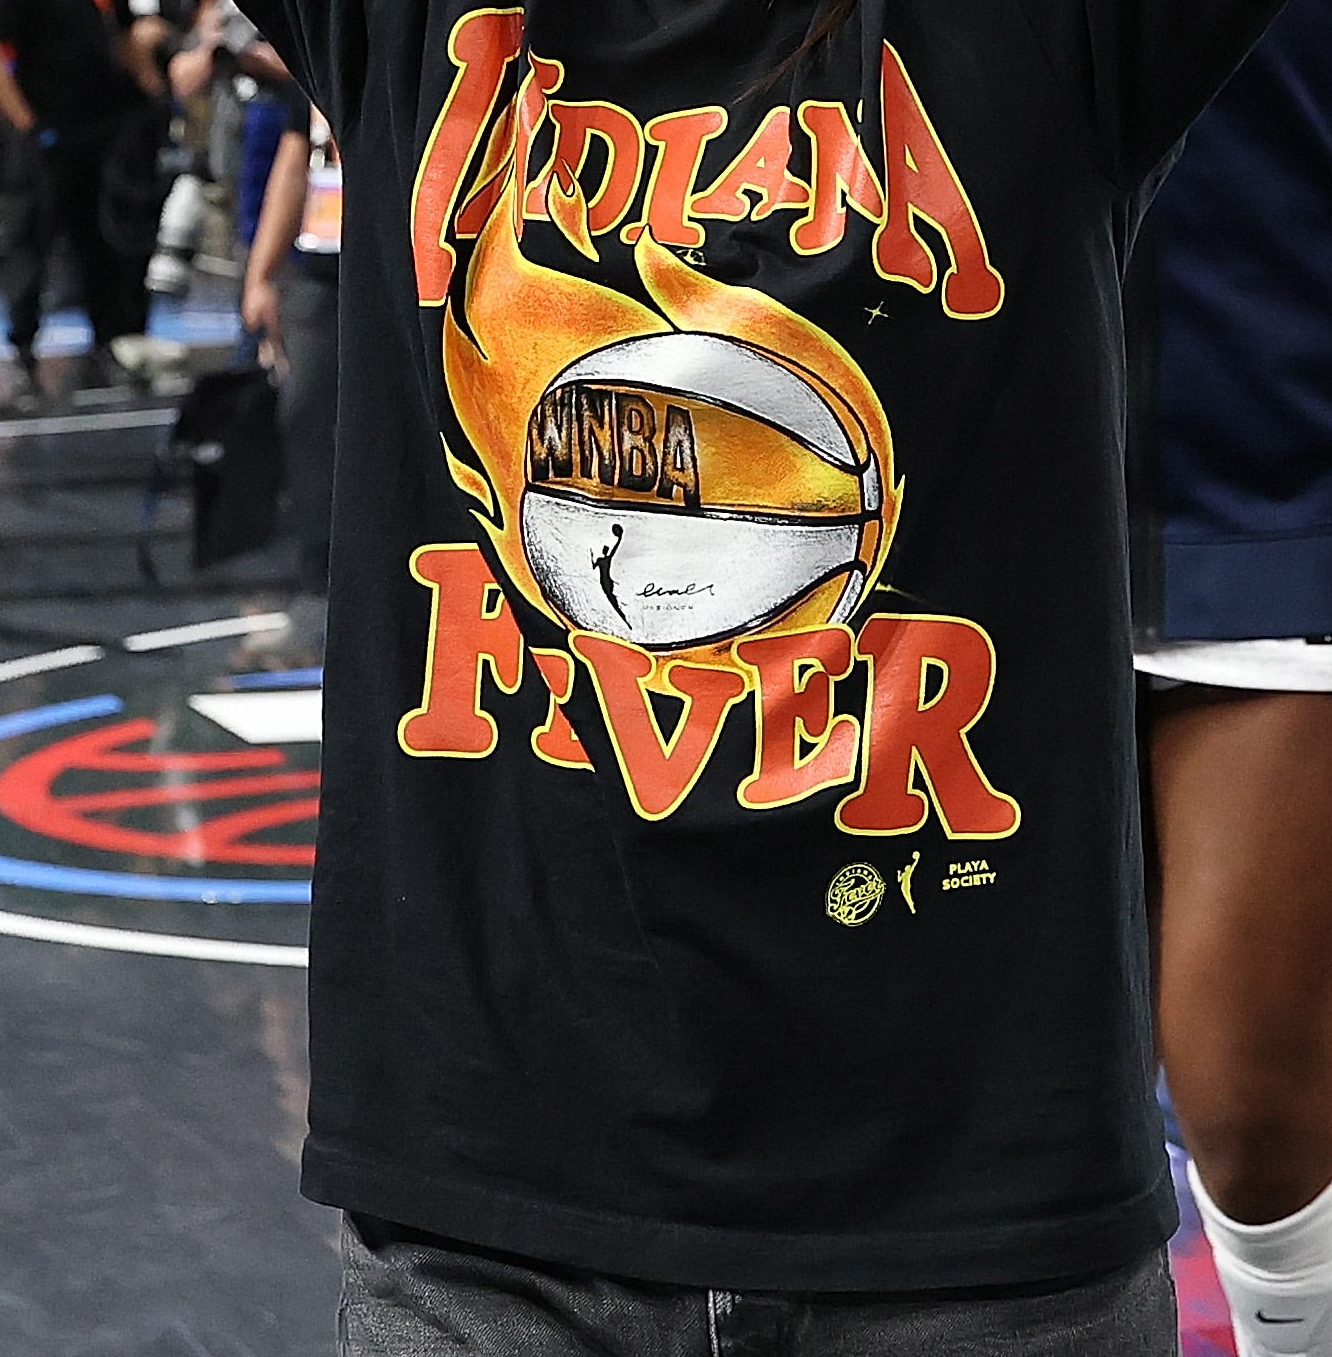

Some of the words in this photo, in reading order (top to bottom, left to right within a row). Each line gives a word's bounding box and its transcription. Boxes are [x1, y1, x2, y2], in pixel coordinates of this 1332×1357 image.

[529, 383, 703, 511] WNBA
[948, 859, 990, 876] PLAYA
[941, 871, 998, 891] SOCIETY
